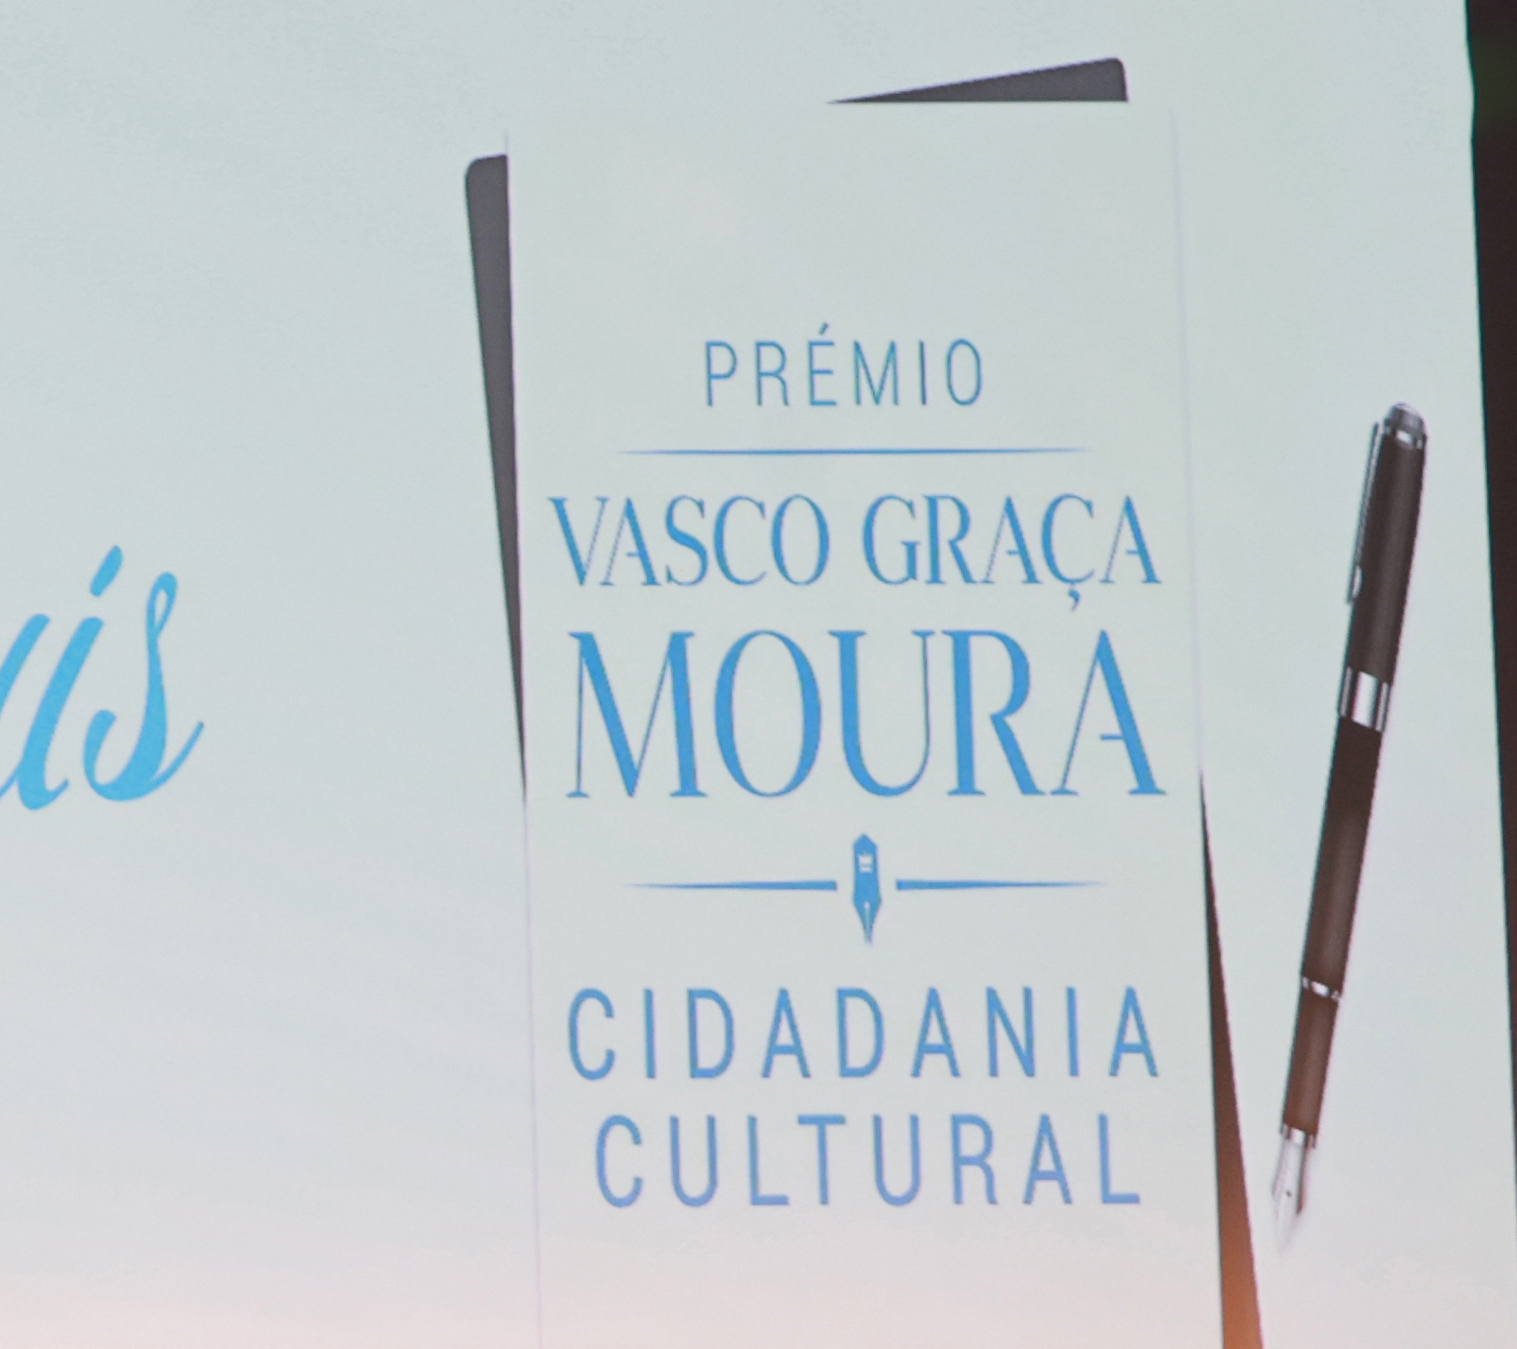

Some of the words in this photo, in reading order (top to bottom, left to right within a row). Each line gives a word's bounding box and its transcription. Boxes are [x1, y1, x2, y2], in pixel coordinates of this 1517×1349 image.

[706, 323, 983, 407] PRÉMIO
[548, 494, 831, 588] VASCO
[861, 493, 1162, 612] GRAÇA
[565, 629, 1167, 799] MOURA
[567, 986, 1160, 1081] CIDADANIA
[593, 1113, 1142, 1208] CULTURAL
